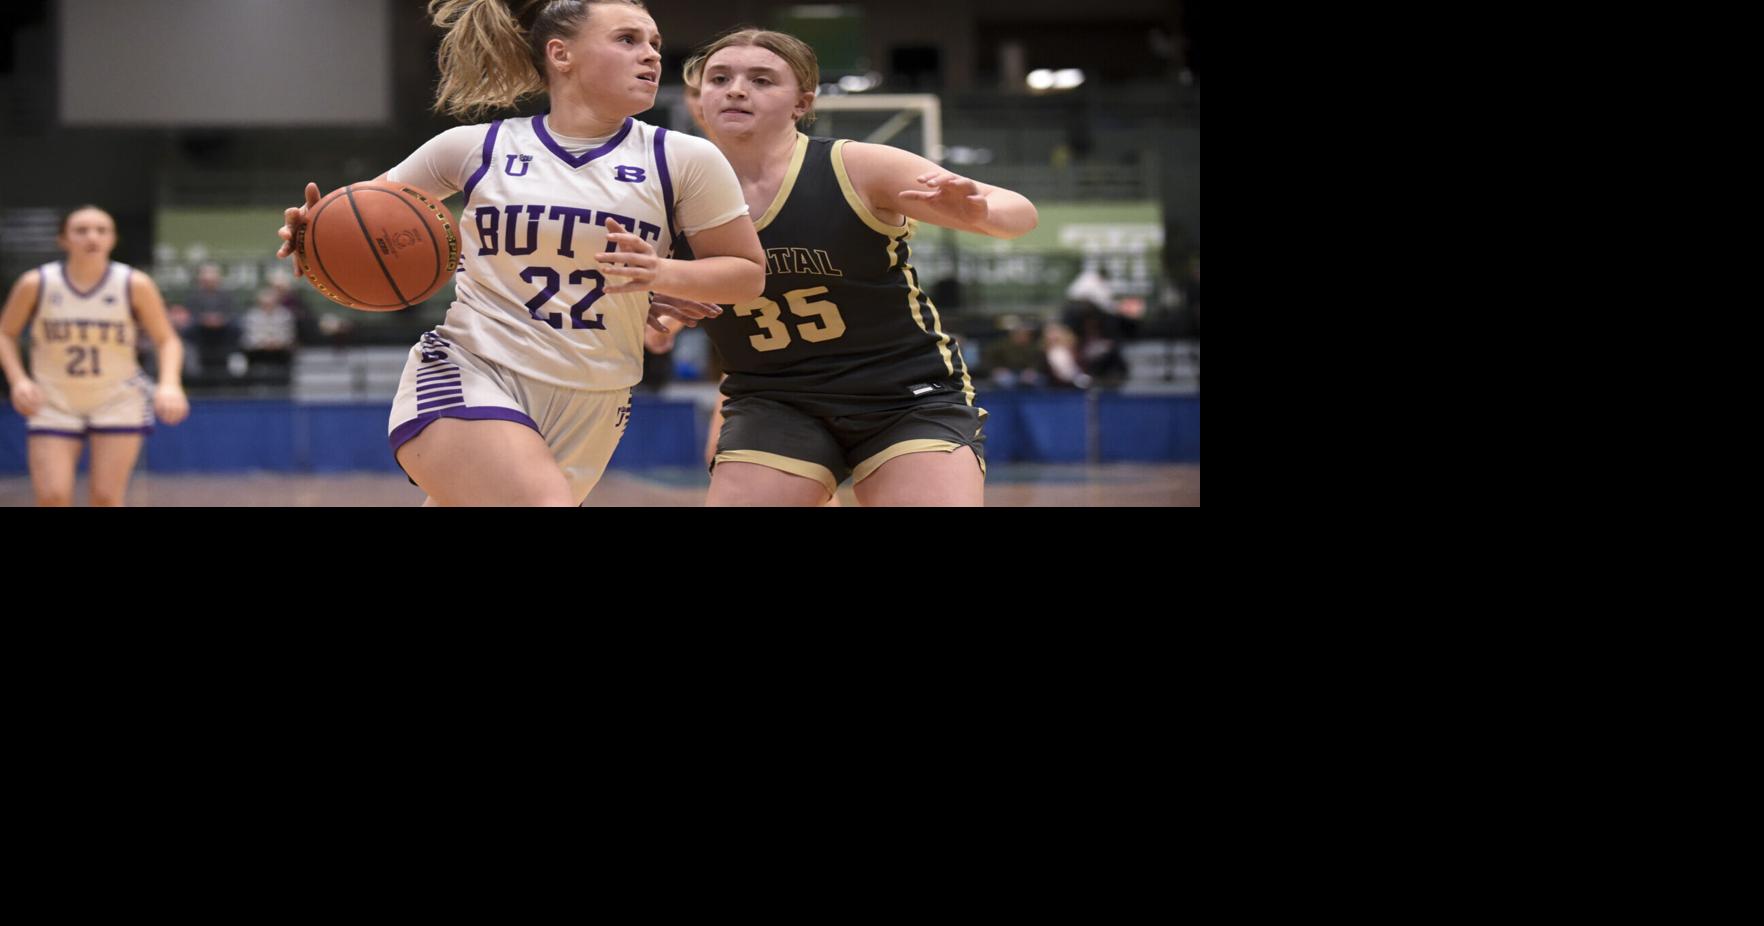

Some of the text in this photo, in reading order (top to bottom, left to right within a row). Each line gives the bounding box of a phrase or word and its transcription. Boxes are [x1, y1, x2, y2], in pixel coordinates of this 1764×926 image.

[614, 164, 647, 184] B
[519, 266, 607, 330] 22
[732, 285, 847, 353] 35
[65, 344, 102, 376] 21
